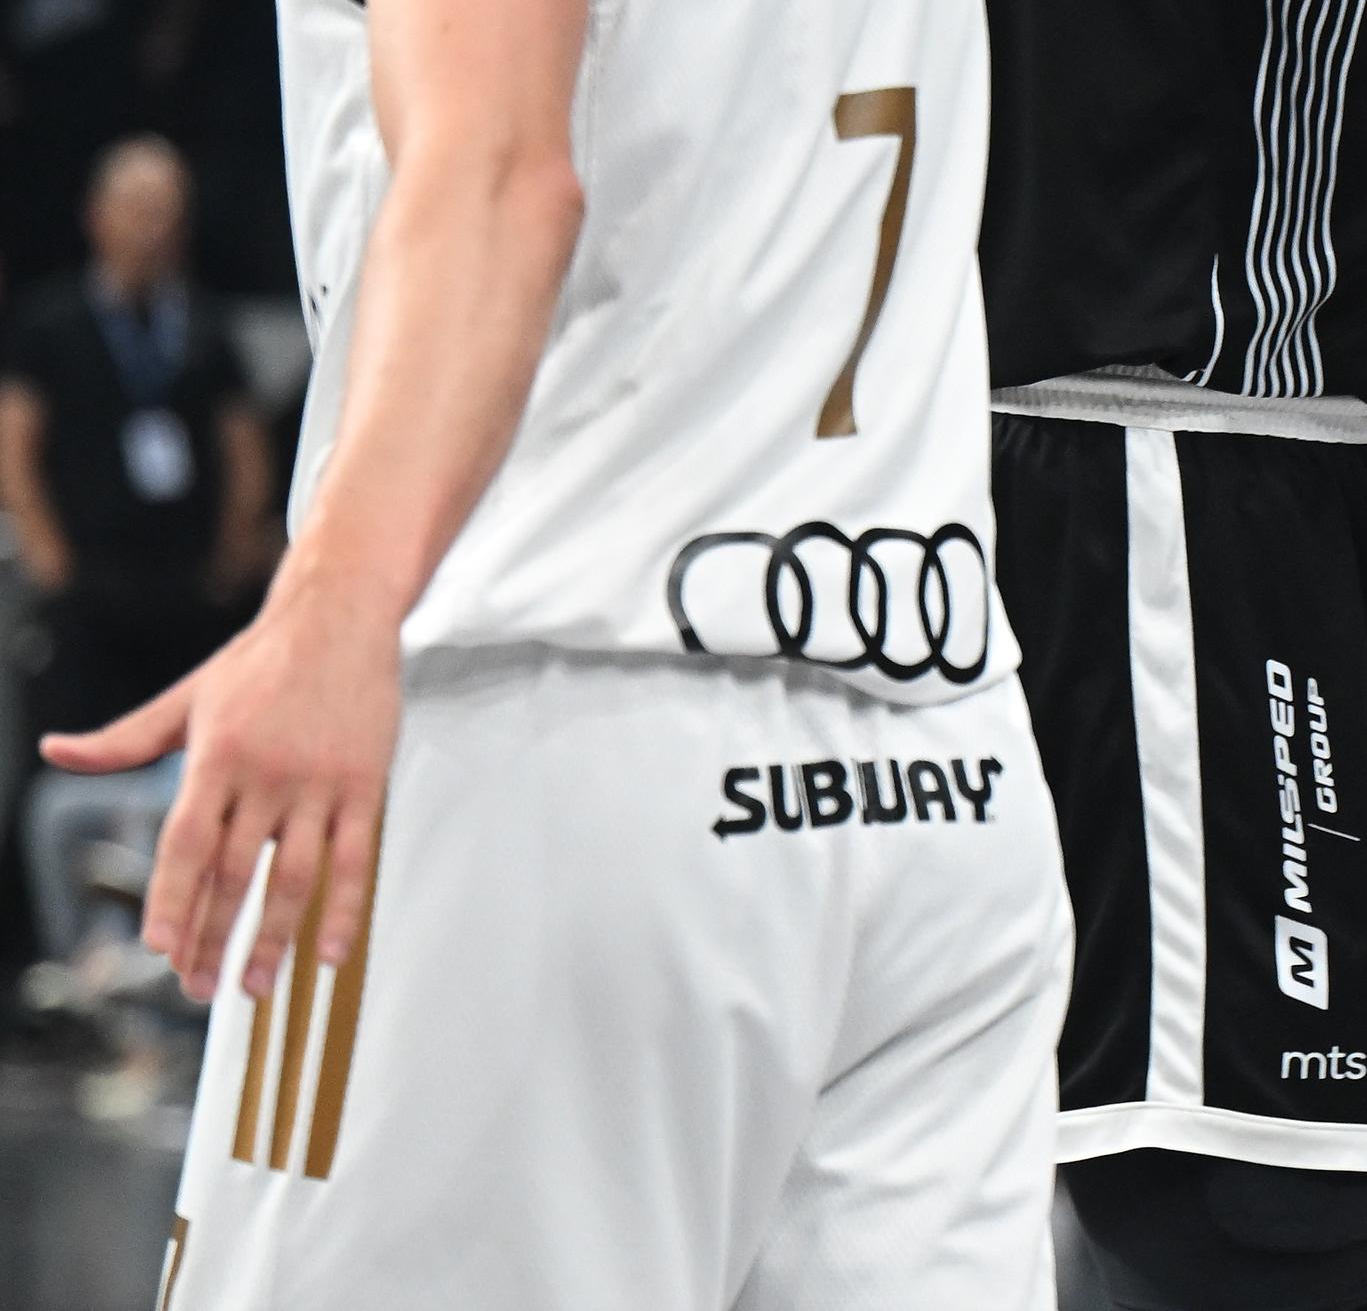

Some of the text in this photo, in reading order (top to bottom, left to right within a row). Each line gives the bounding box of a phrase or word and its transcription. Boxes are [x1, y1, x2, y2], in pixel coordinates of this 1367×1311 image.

[814, 86, 917, 440] 7
[711, 755, 1004, 842] SUBWAY
[1266, 658, 1313, 914] MILSPED
[1307, 677, 1339, 814] GROUP
[1280, 1045, 1367, 1081] mts
